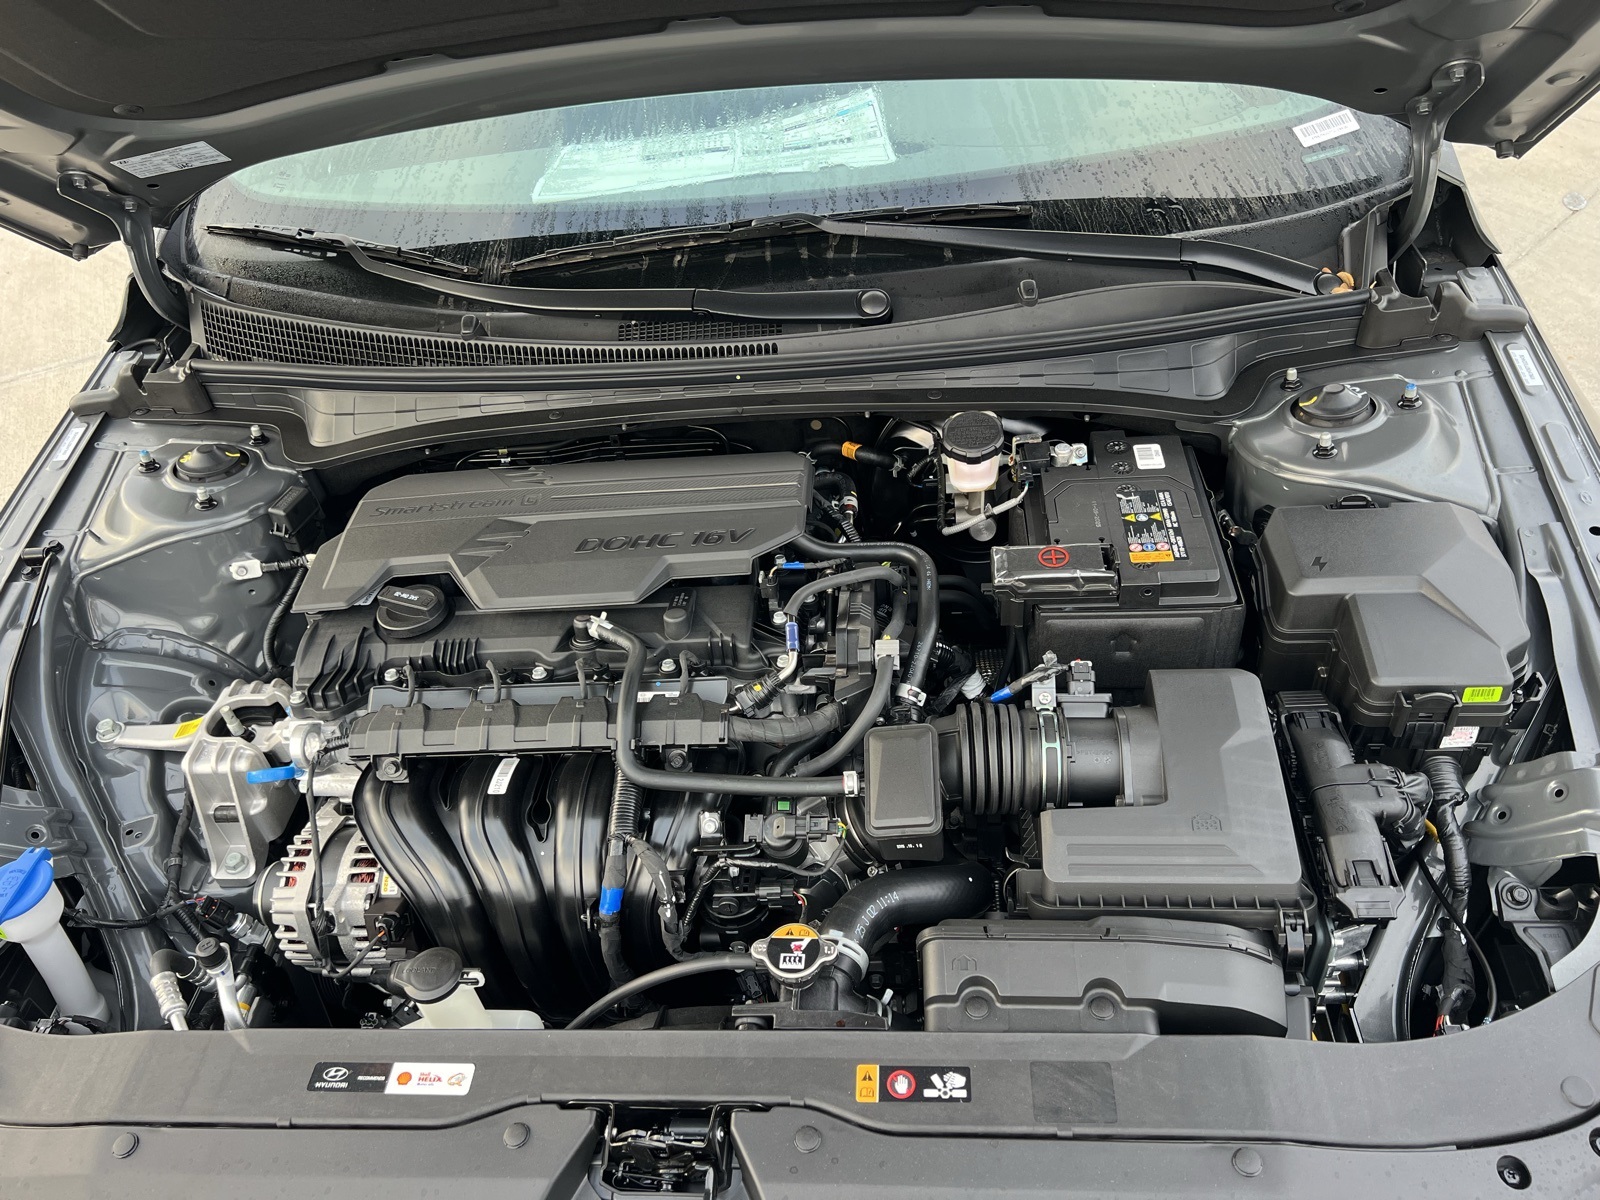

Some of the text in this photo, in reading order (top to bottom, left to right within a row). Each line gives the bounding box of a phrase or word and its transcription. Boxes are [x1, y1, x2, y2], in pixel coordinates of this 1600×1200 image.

[370, 499, 516, 517] Smartstream
[574, 527, 756, 553] DOHC 16V
[854, 891, 900, 939] 25 J 02 11:14
[314, 1081, 349, 1089] HYUNDAI
[417, 1075, 443, 1083] HELIX
